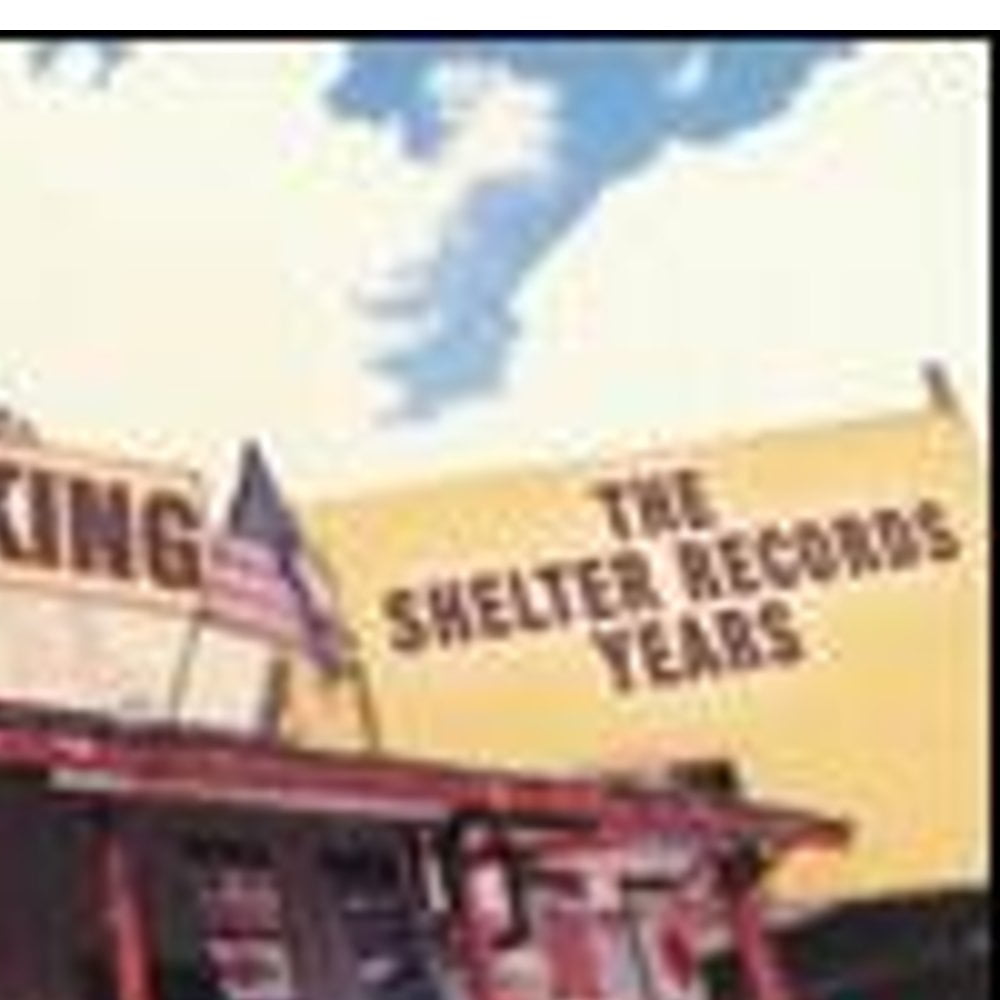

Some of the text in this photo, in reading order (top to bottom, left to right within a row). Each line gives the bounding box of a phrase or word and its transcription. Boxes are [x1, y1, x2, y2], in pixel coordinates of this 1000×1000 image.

[591, 467, 716, 540] THE
[382, 499, 962, 653] SHELTER RECORDS
[591, 600, 804, 695] YEARS
